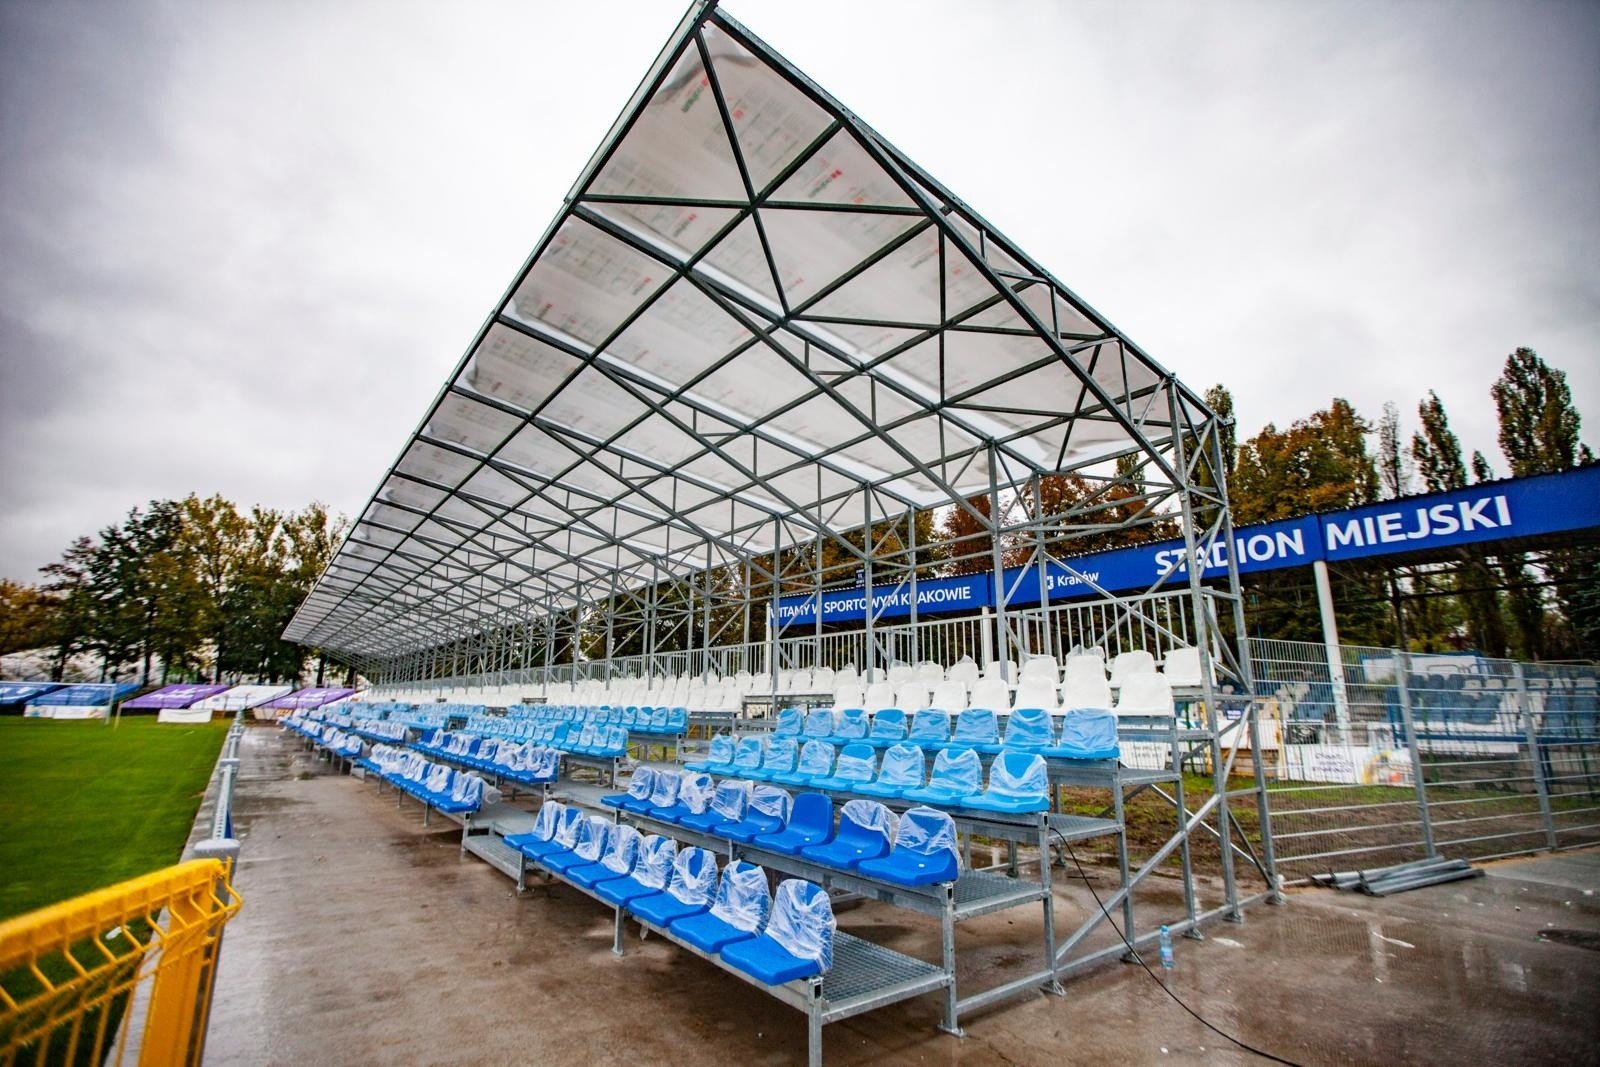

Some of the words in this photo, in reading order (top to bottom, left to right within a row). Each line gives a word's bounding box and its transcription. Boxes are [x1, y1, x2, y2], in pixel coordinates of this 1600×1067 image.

[1154, 528, 1305, 576] STADION
[1326, 495, 1512, 551] MIEJSKI
[1057, 570, 1099, 587] Kraków
[824, 593, 899, 613] SPORTOWYM
[901, 586, 971, 606] KAKOWIE
